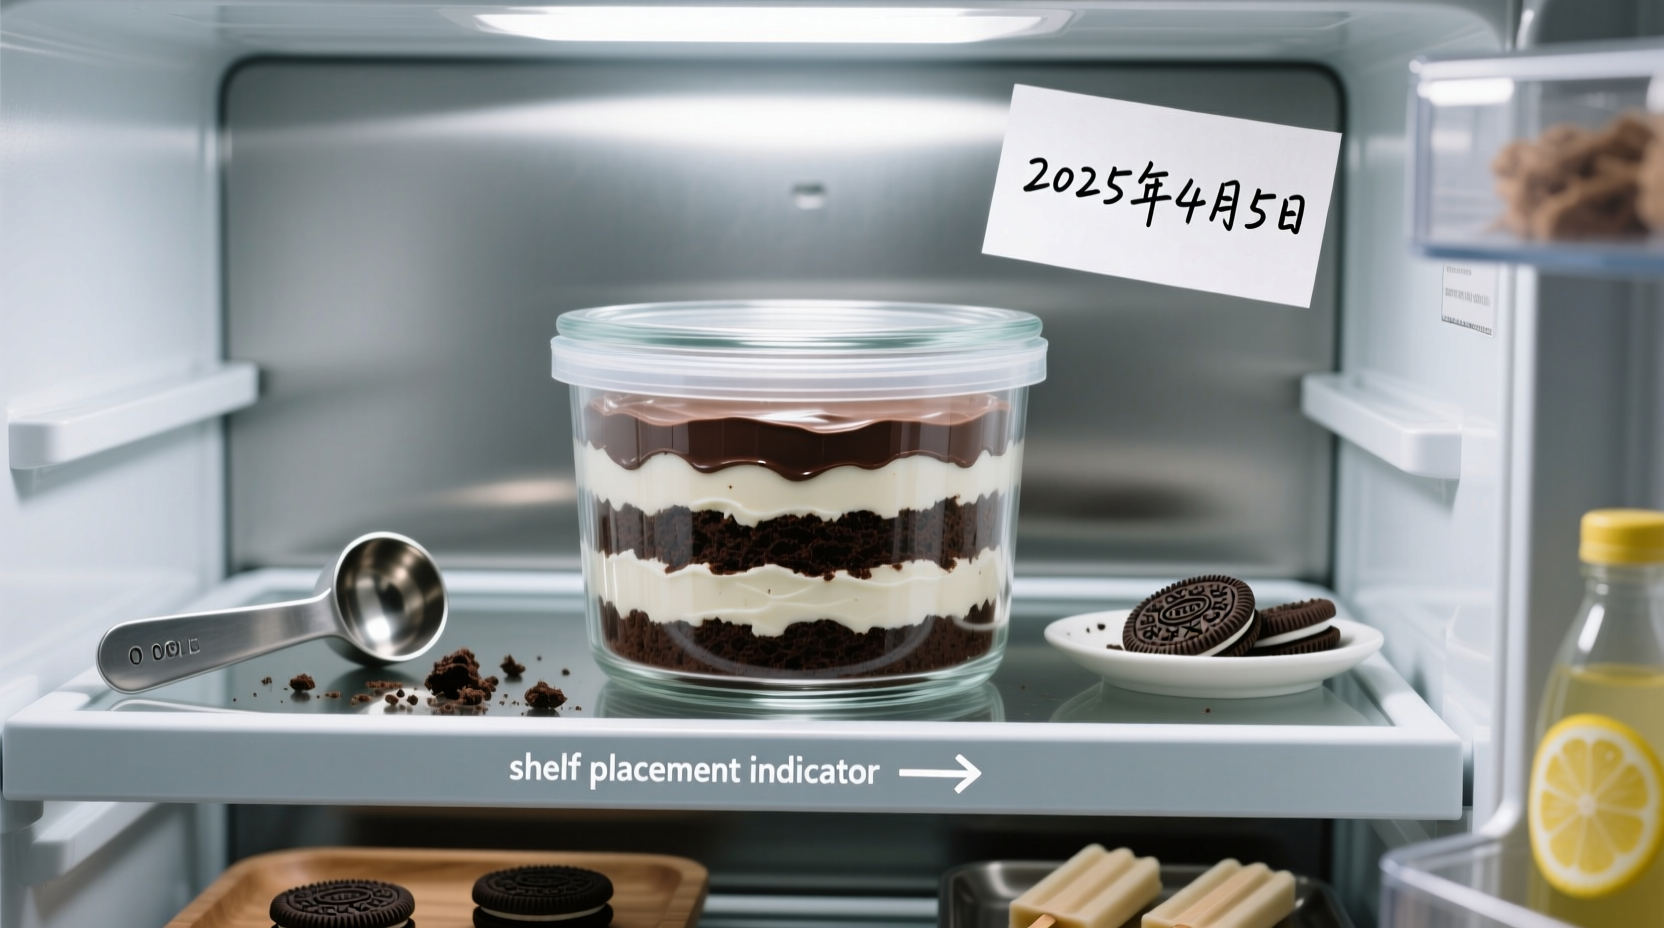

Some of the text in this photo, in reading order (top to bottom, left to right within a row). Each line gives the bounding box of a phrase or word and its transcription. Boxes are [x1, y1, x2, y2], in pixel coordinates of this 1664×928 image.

[1023, 157, 1305, 235] 2025年4月5日
[509, 752, 880, 790] shelf placement indicator
